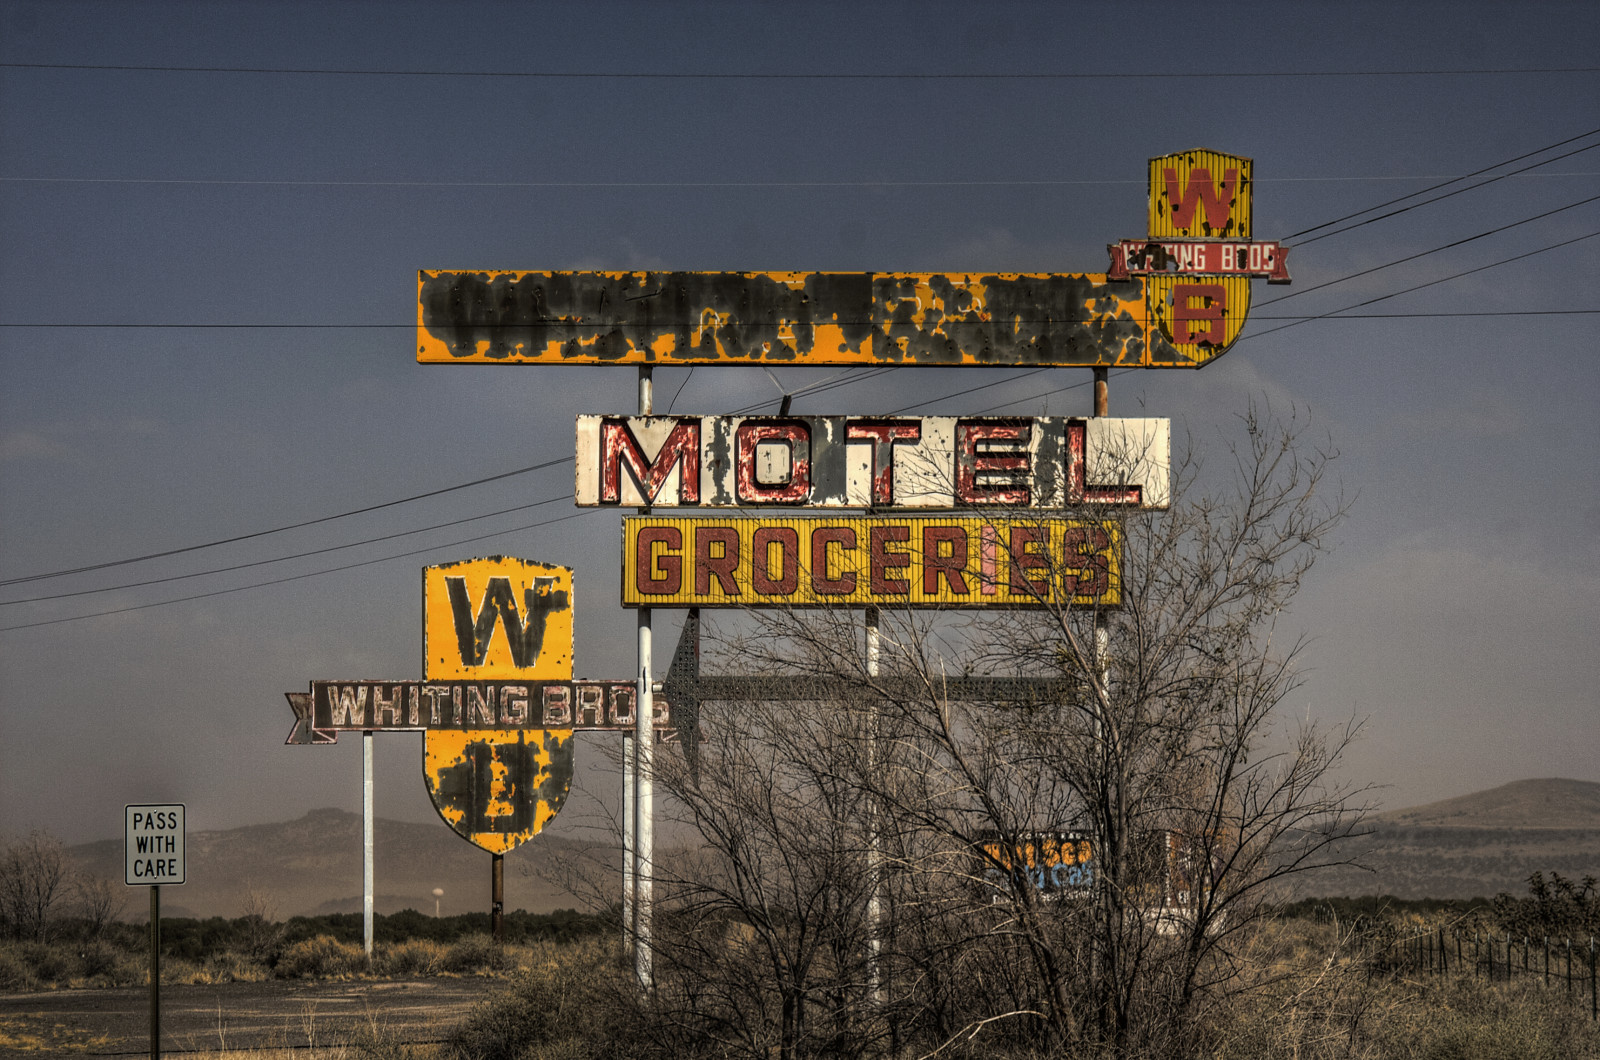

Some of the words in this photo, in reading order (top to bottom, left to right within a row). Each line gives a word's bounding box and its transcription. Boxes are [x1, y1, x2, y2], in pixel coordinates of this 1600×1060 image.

[1162, 167, 1239, 229] W
[1123, 244, 1205, 270] WTING
[1172, 284, 1227, 344] B
[599, 418, 1143, 505] MOTEL
[636, 526, 1109, 595] GROCERIES
[444, 575, 558, 668] W
[327, 685, 528, 725] WHITING
[133, 812, 177, 830] PASS
[135, 835, 175, 853] WITH
[134, 859, 177, 877] CARE
